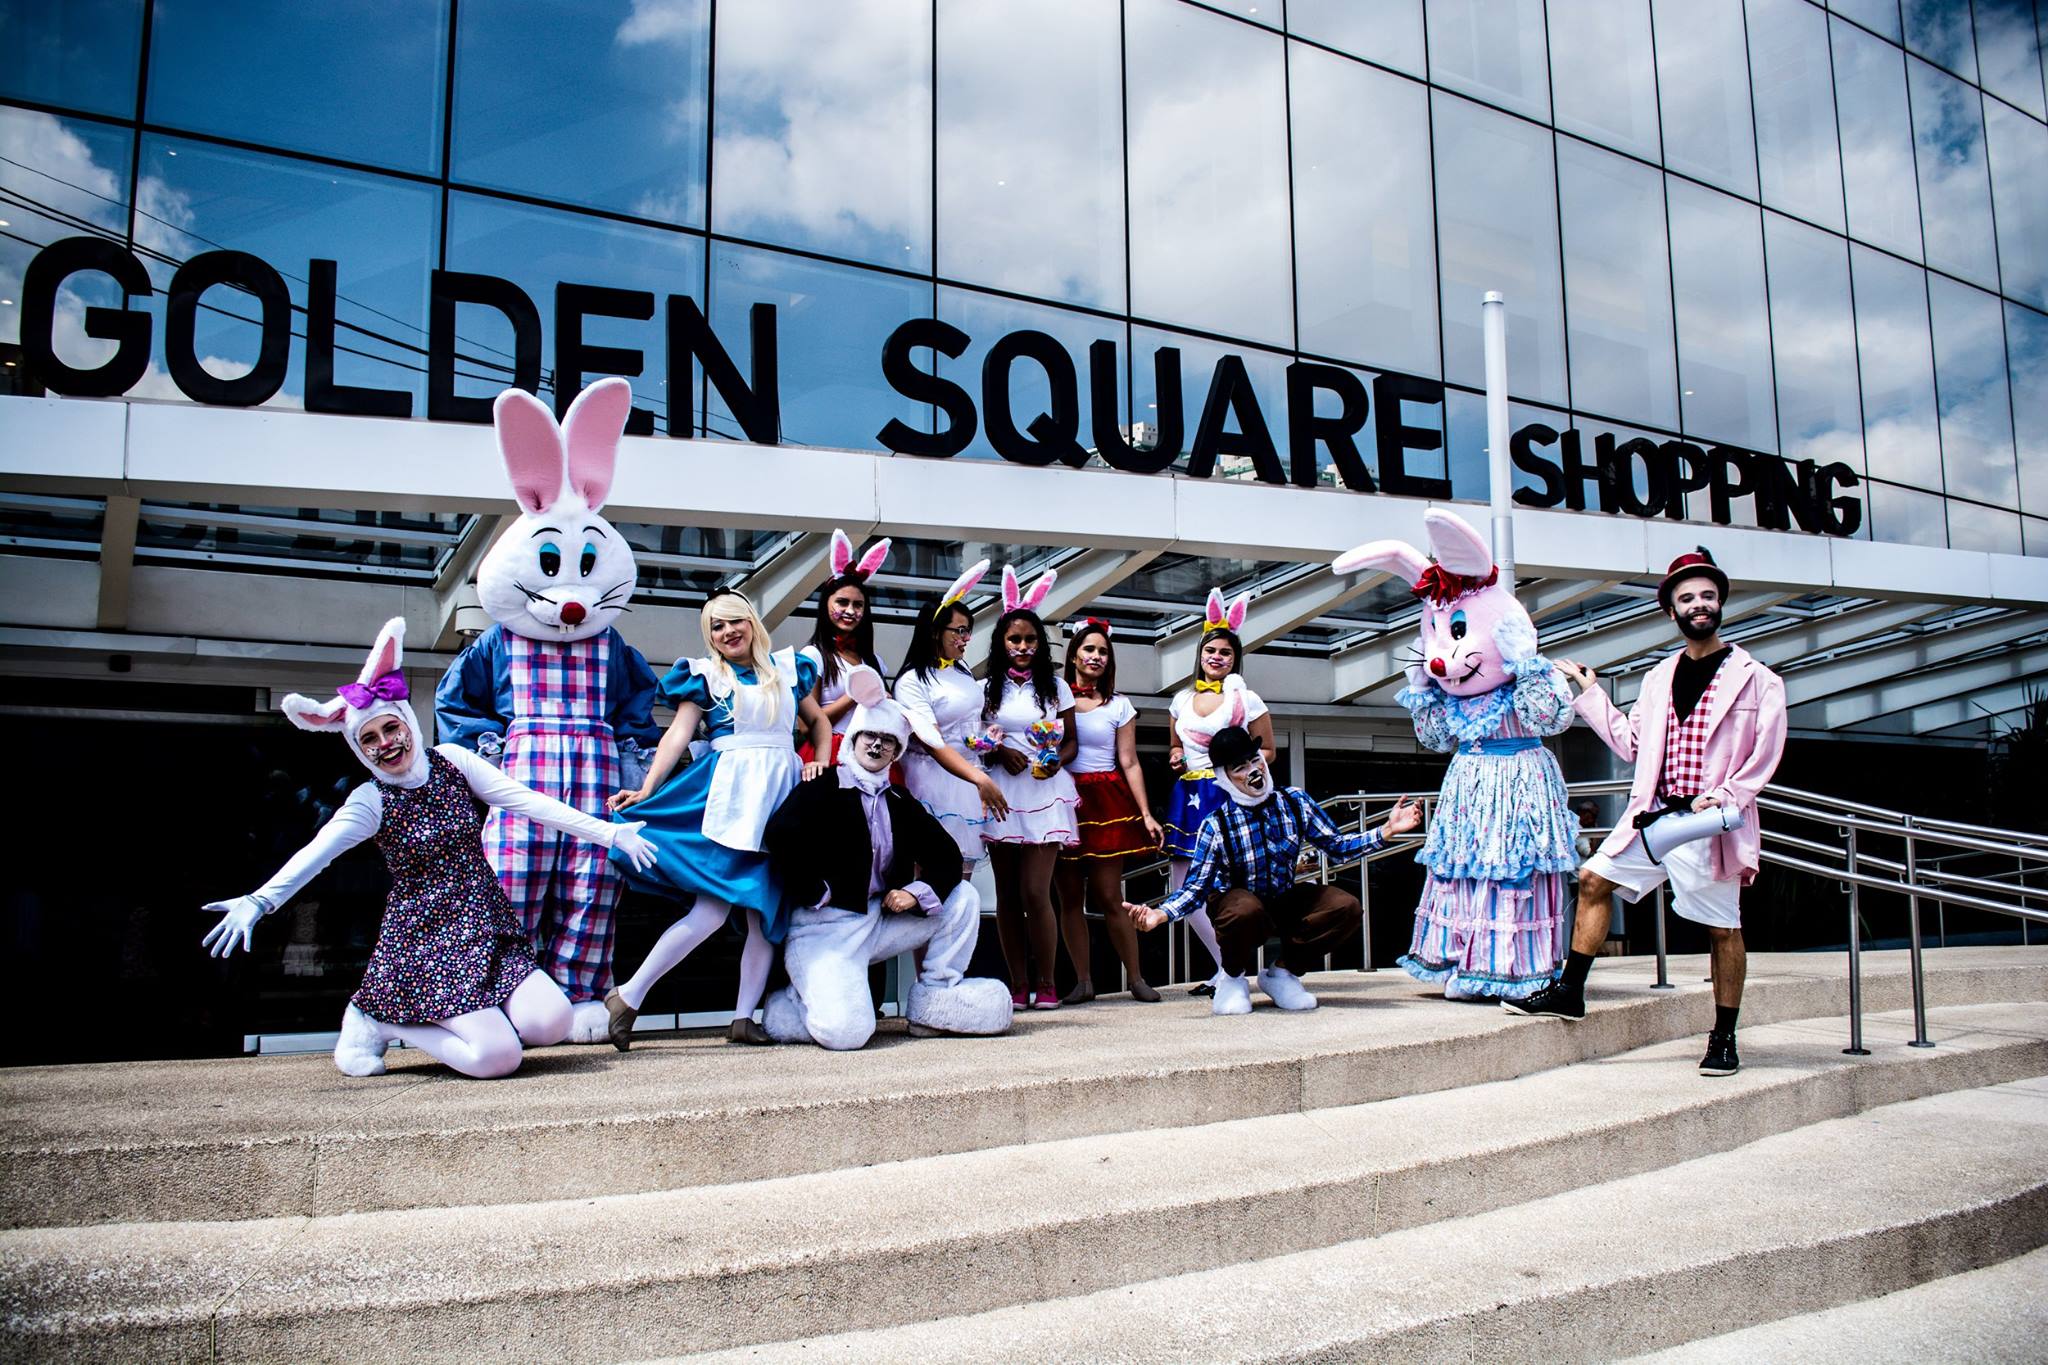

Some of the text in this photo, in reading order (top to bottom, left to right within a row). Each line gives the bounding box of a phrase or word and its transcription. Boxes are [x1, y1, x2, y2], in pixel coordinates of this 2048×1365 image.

[19, 236, 1862, 536] GOLDEN SQUARE SHOPPING
